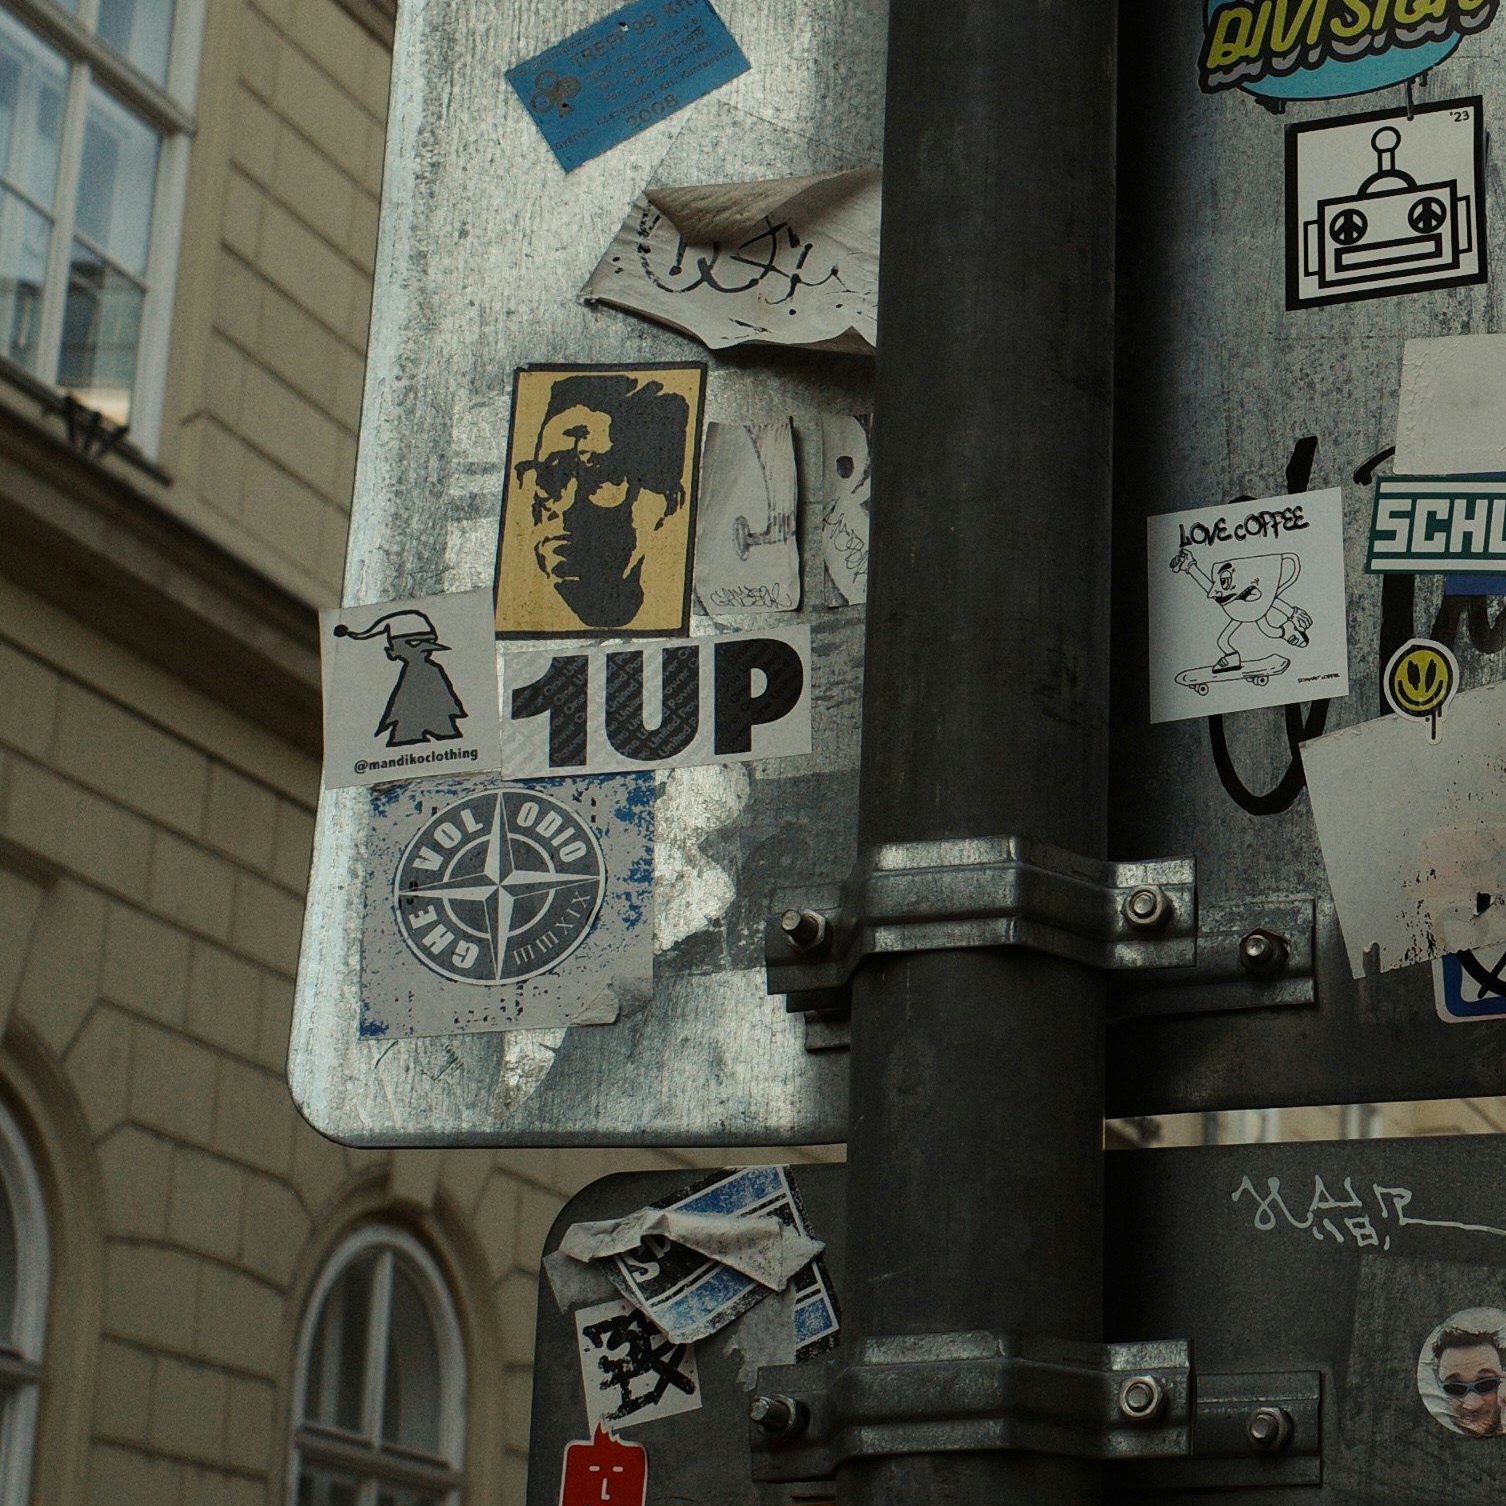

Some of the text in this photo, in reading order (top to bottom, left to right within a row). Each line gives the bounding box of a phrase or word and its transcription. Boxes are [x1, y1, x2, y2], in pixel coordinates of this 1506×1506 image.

[625, 93, 679, 127] 2008
[1448, 108, 1470, 124] '23
[1178, 516, 1234, 548] LOVE
[511, 637, 805, 769] 1UP
[353, 747, 479, 775] @mandikoclothing
[407, 800, 588, 970] GHE VOL ODIO
